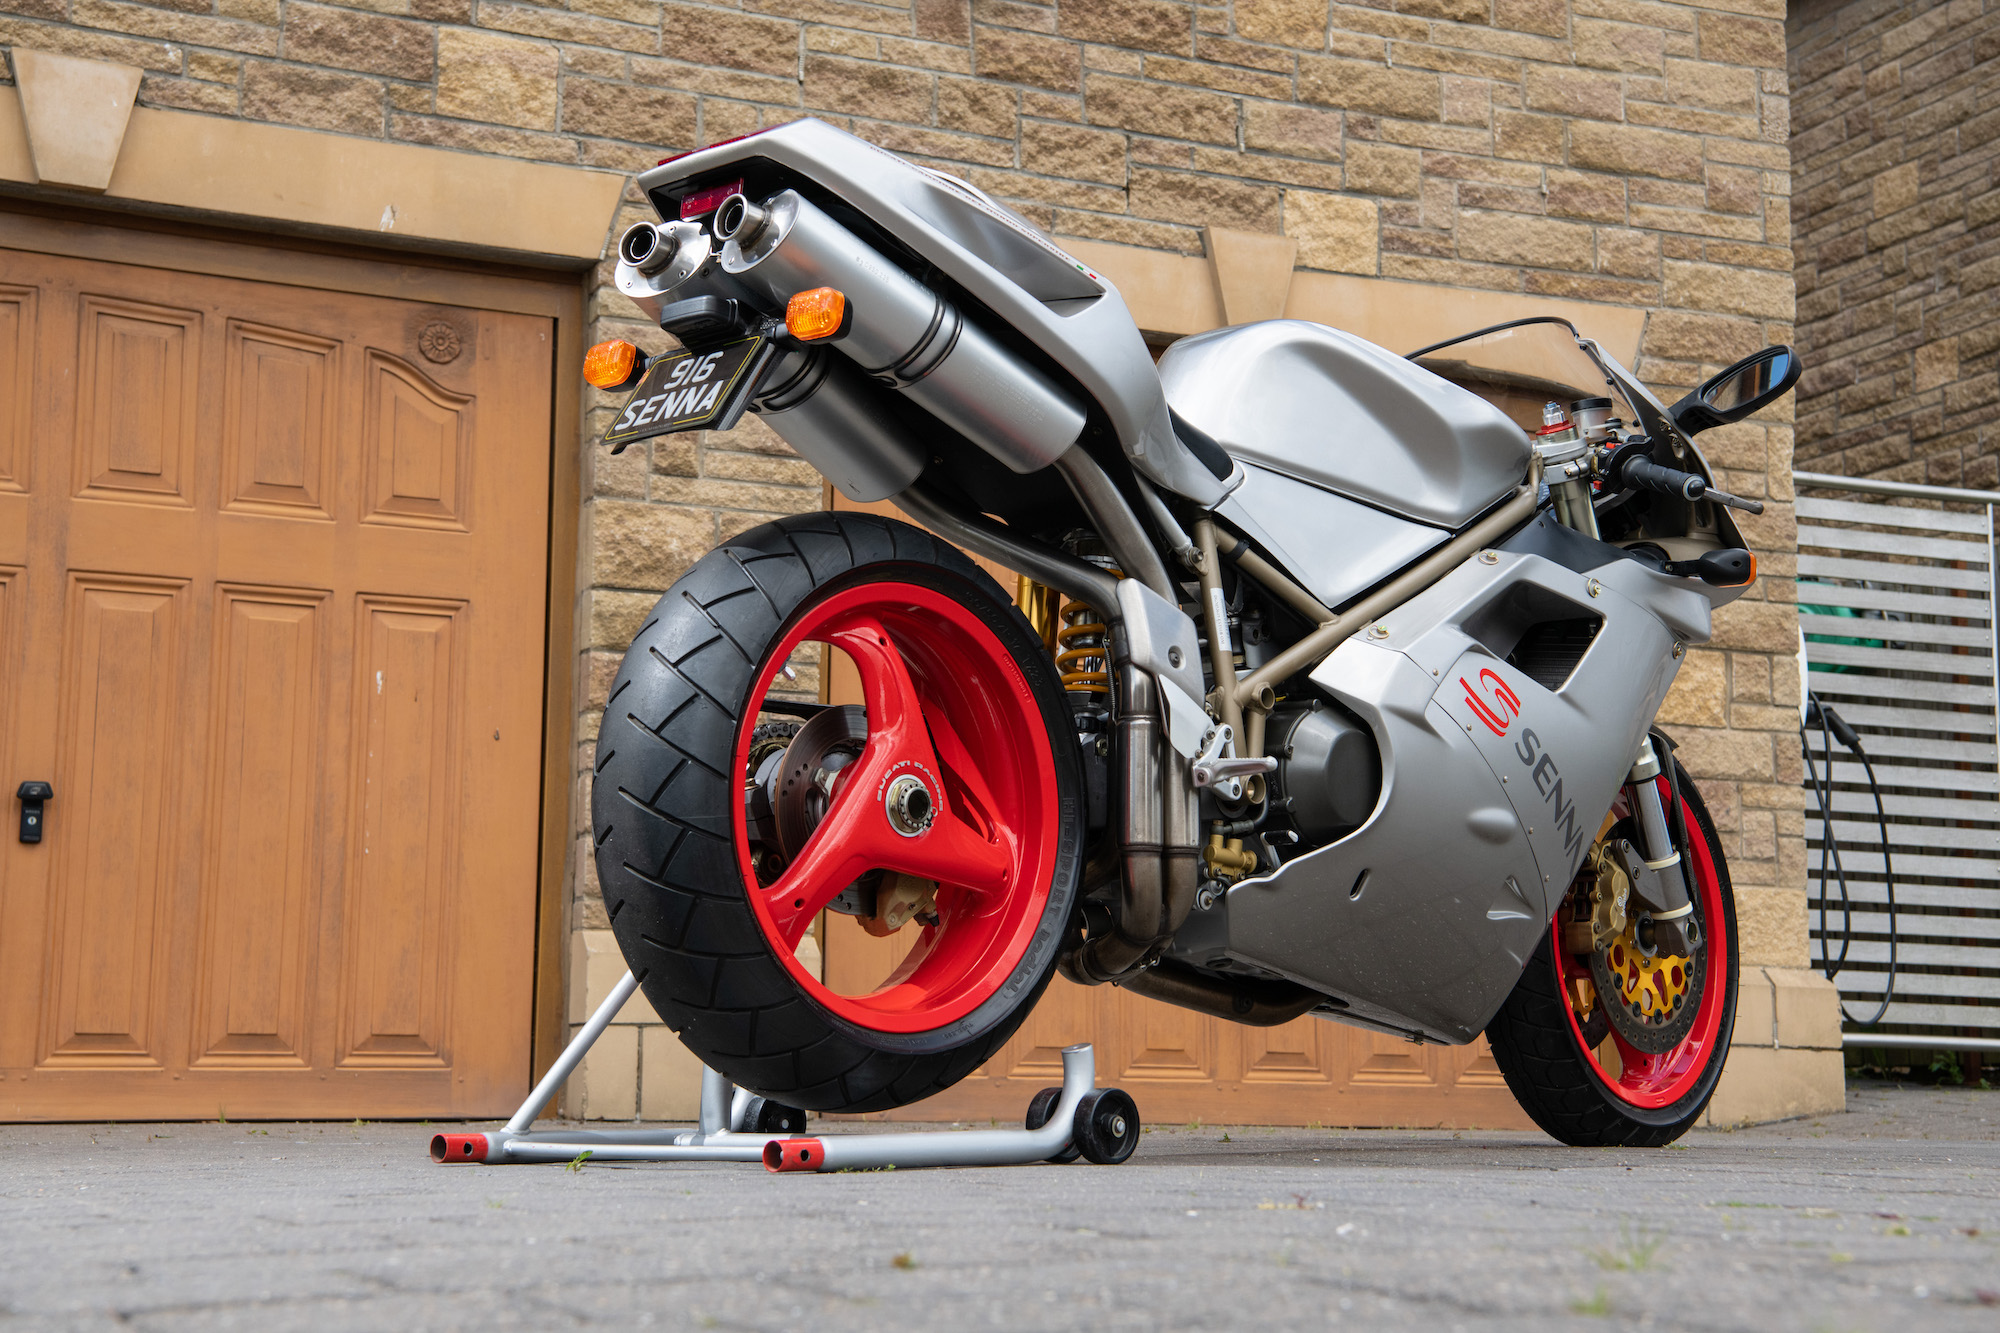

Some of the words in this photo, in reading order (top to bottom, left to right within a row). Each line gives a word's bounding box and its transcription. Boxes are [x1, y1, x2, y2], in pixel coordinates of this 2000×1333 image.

[664, 351, 724, 390] 916
[615, 380, 724, 431] SENNA
[876, 760, 911, 802] DUCATI
[914, 761, 944, 811] RACING
[1515, 727, 1584, 880] SENNA
[1047, 797, 1076, 917] HI-SPORT
